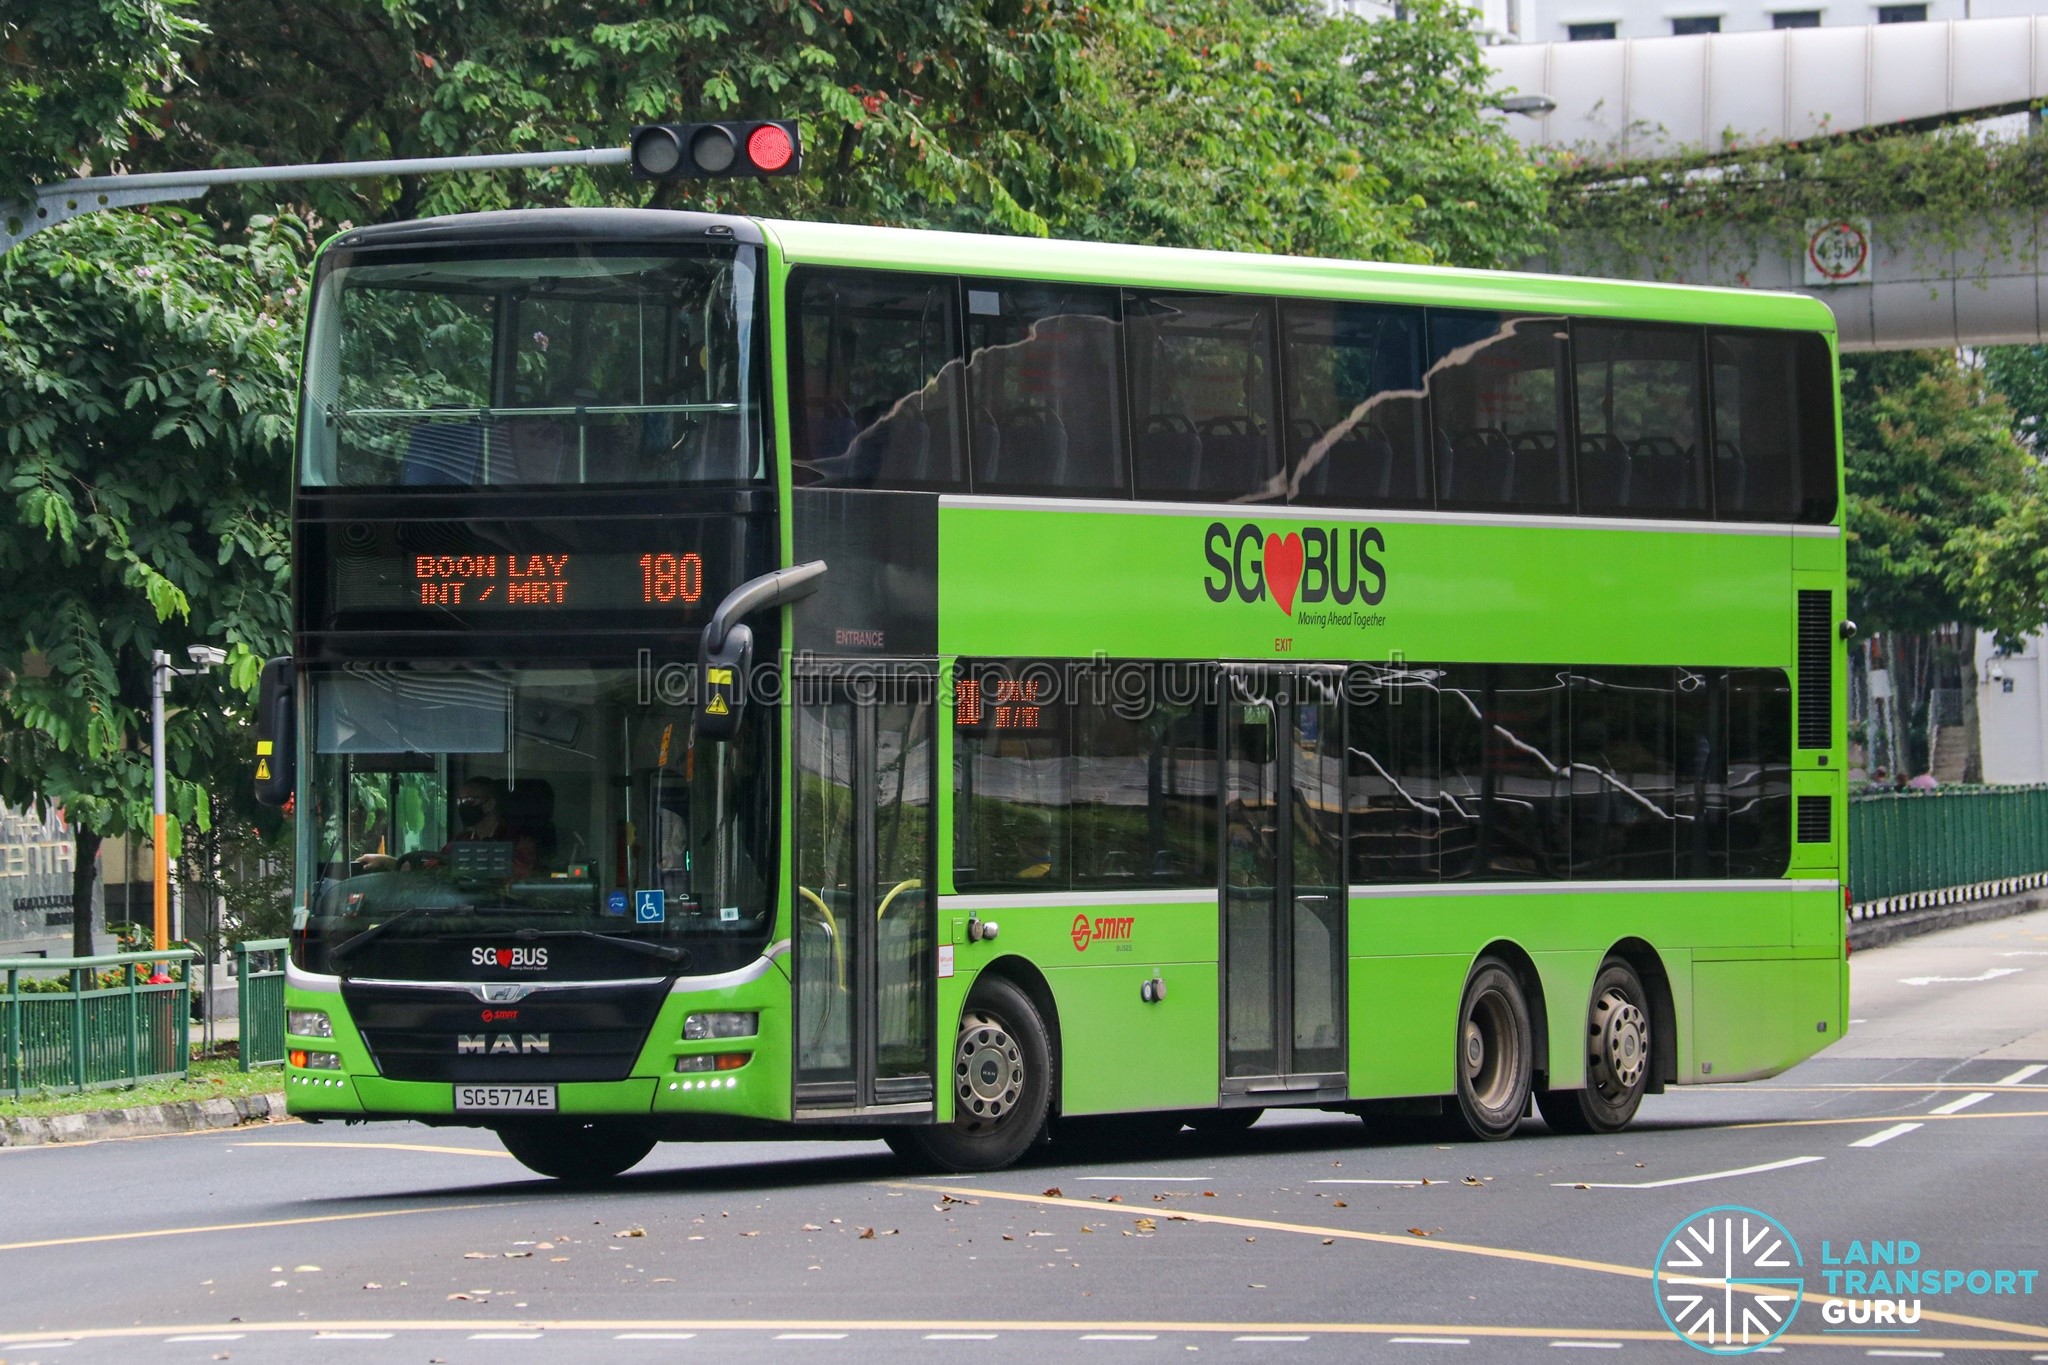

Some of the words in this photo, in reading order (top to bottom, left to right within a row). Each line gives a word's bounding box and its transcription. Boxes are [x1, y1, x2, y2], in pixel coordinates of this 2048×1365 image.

[416, 555, 496, 579] BOON
[508, 554, 569, 578] LAY
[639, 552, 703, 603] 180
[420, 582, 466, 605] INT
[508, 582, 569, 605] MRT
[1298, 612, 1326, 629] Moving
[1327, 611, 1352, 626] Ahead
[1353, 612, 1386, 630] Together
[836, 630, 885, 648] ENTRANCE
[1275, 638, 1293, 652] EXIT
[1091, 917, 1135, 940] SMRT
[494, 1010, 519, 1019] SMRT
[458, 1034, 549, 1054] MAN
[463, 1089, 550, 1106] SG5774E
